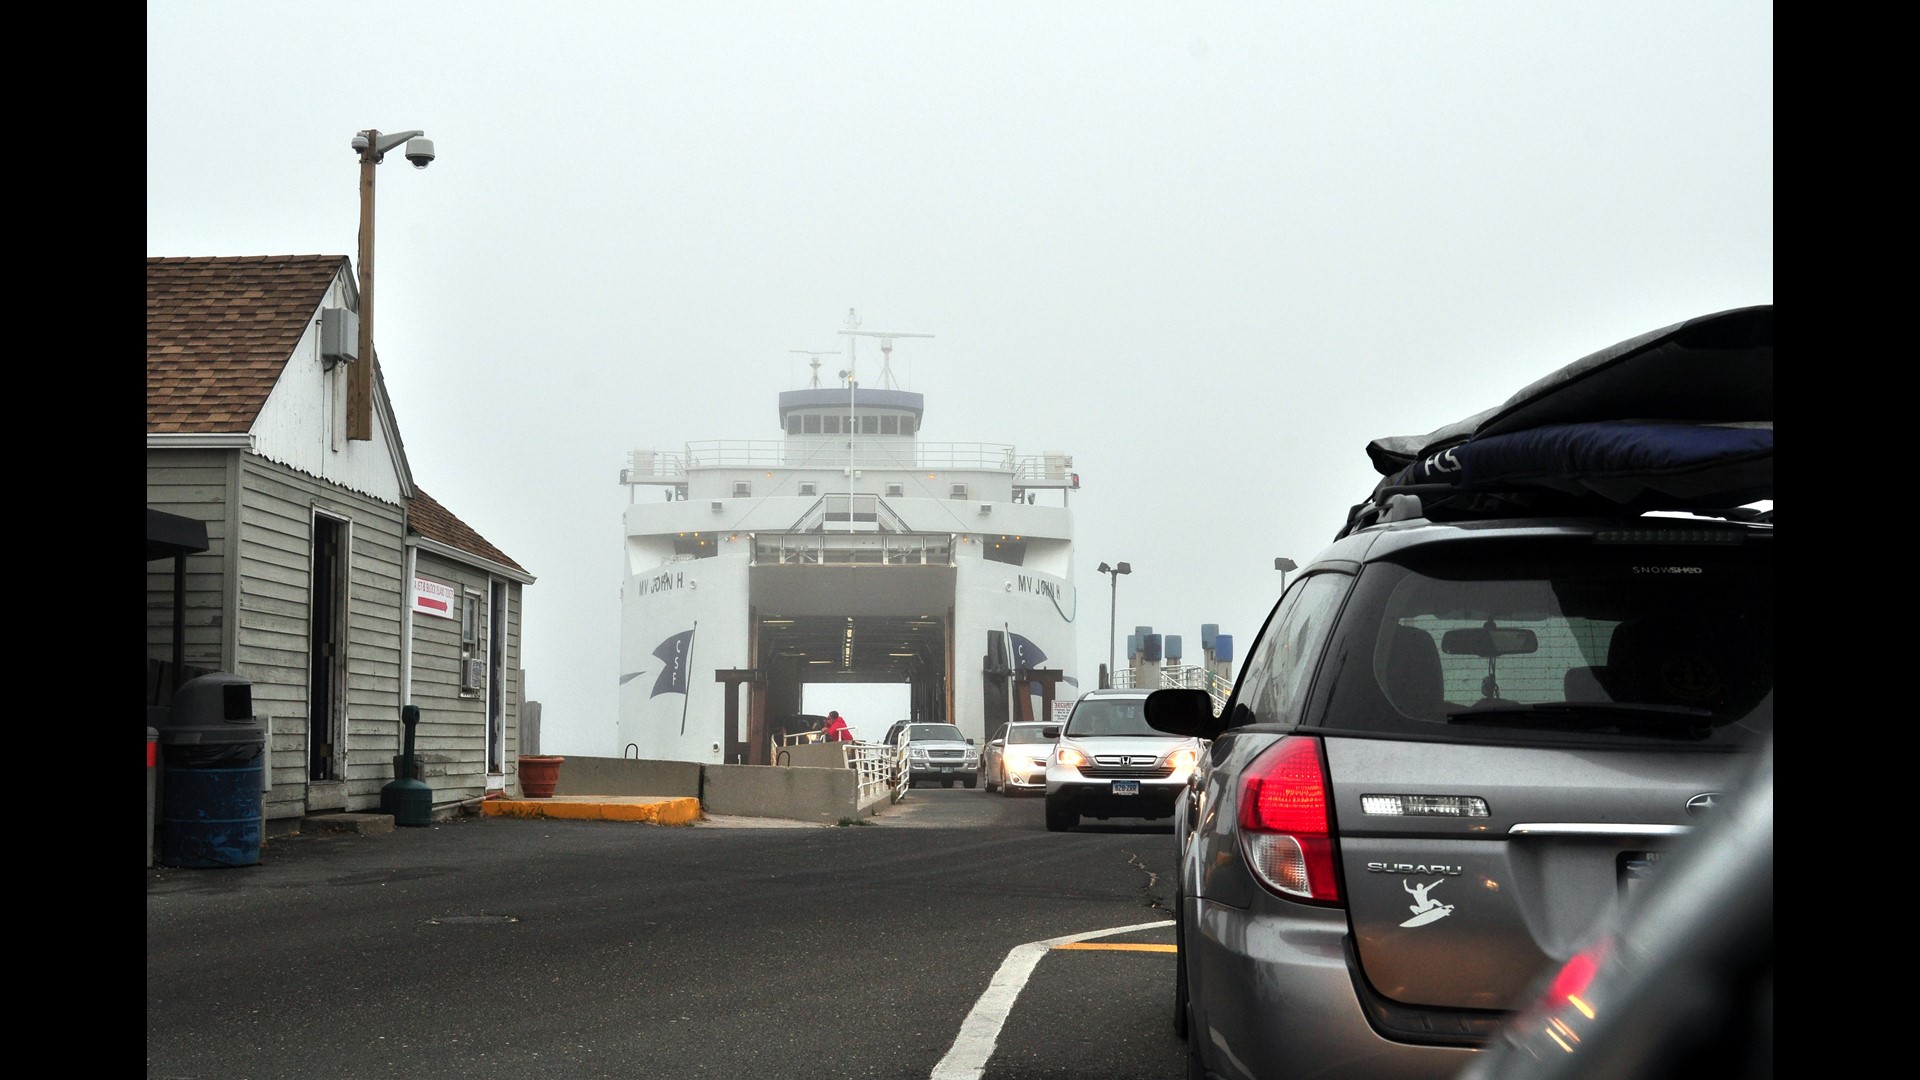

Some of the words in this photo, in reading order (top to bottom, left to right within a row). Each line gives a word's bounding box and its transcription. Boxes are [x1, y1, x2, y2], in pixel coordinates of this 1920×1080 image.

[639, 579, 649, 596] MV
[650, 573, 673, 594] JOHN
[677, 571, 684, 589] H
[1018, 574, 1032, 593] MV
[1035, 579, 1055, 599] JOHN
[1056, 584, 1061, 600] H
[1367, 862, 1462, 876] SUBARU
